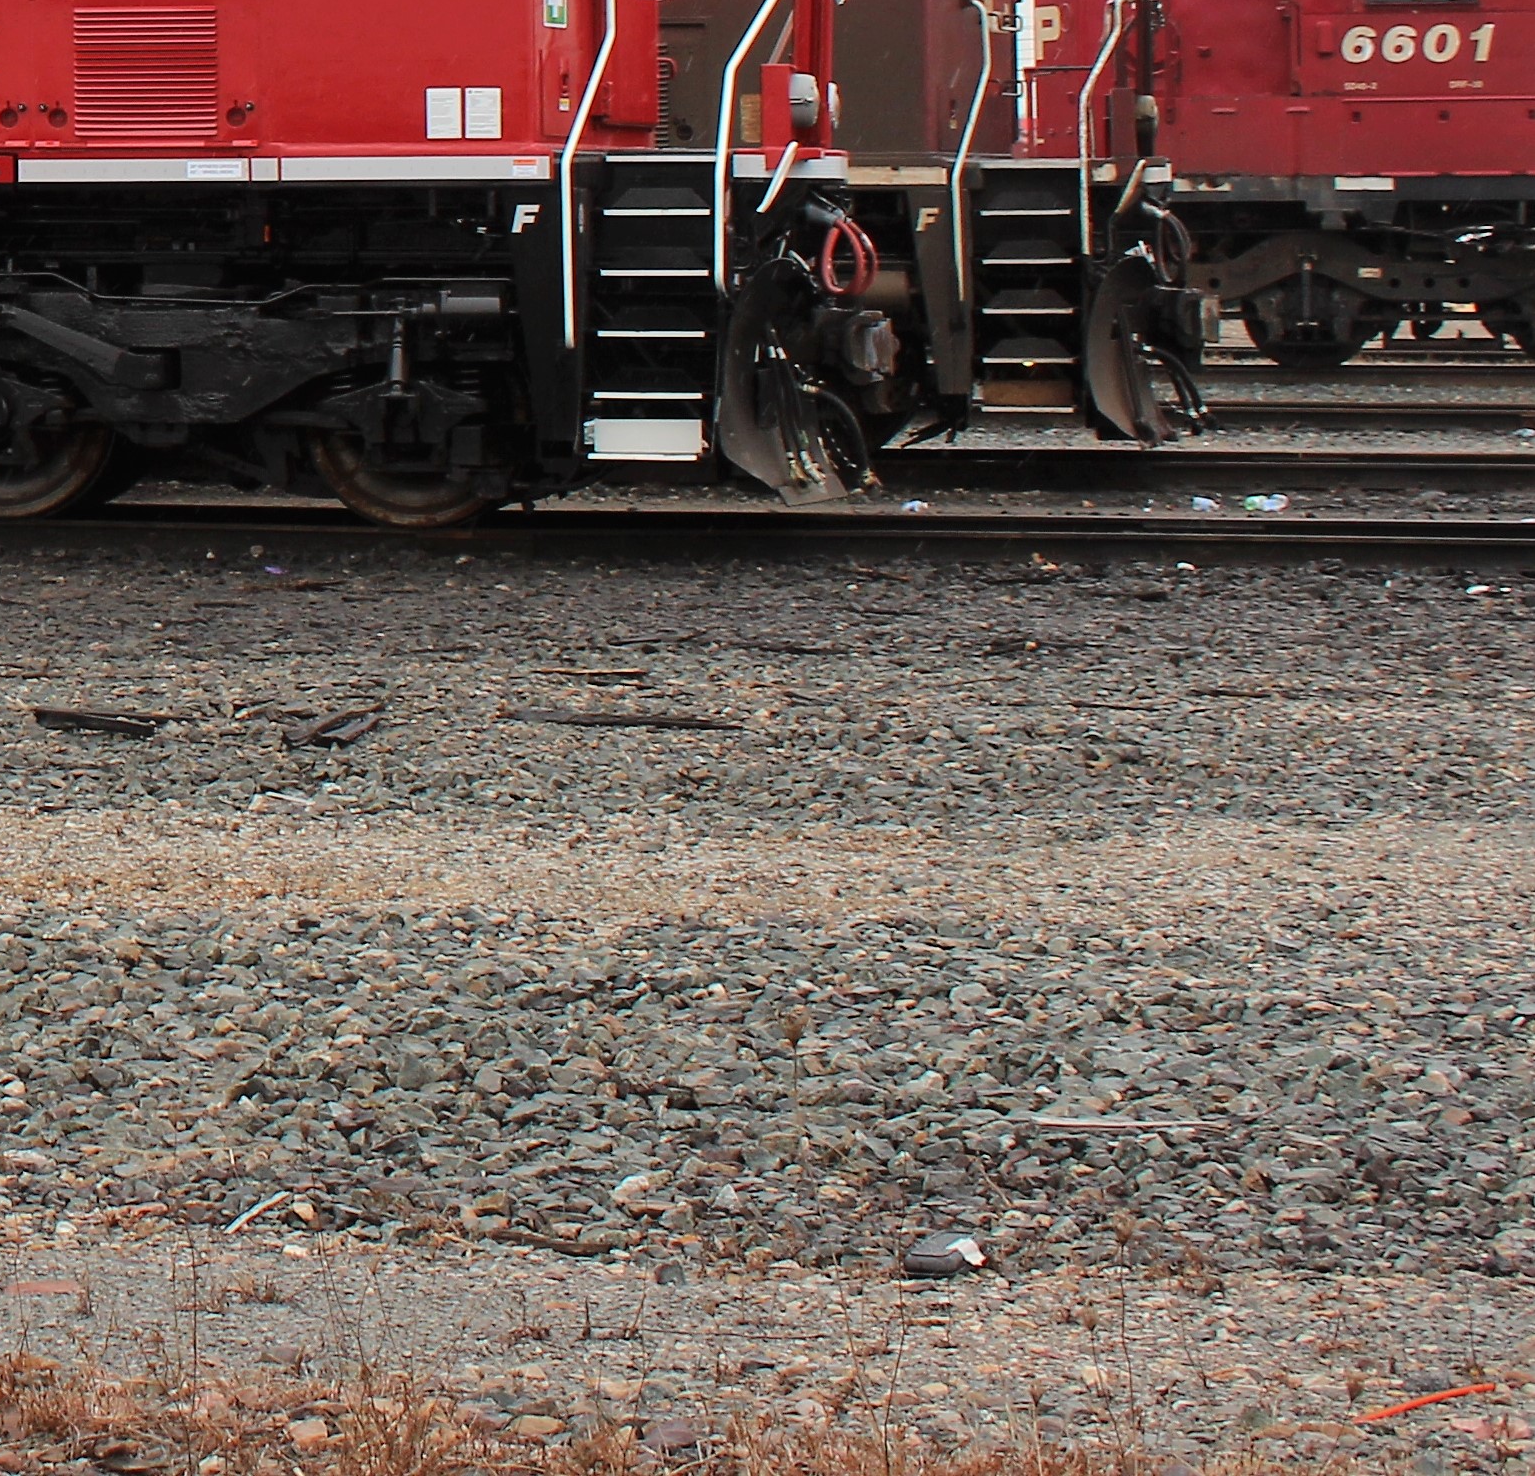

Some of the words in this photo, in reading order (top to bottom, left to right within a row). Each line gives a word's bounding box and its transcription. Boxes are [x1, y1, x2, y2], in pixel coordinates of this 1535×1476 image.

[1340, 23, 1496, 63] 6601
[511, 204, 541, 234] F
[915, 207, 939, 233] F
